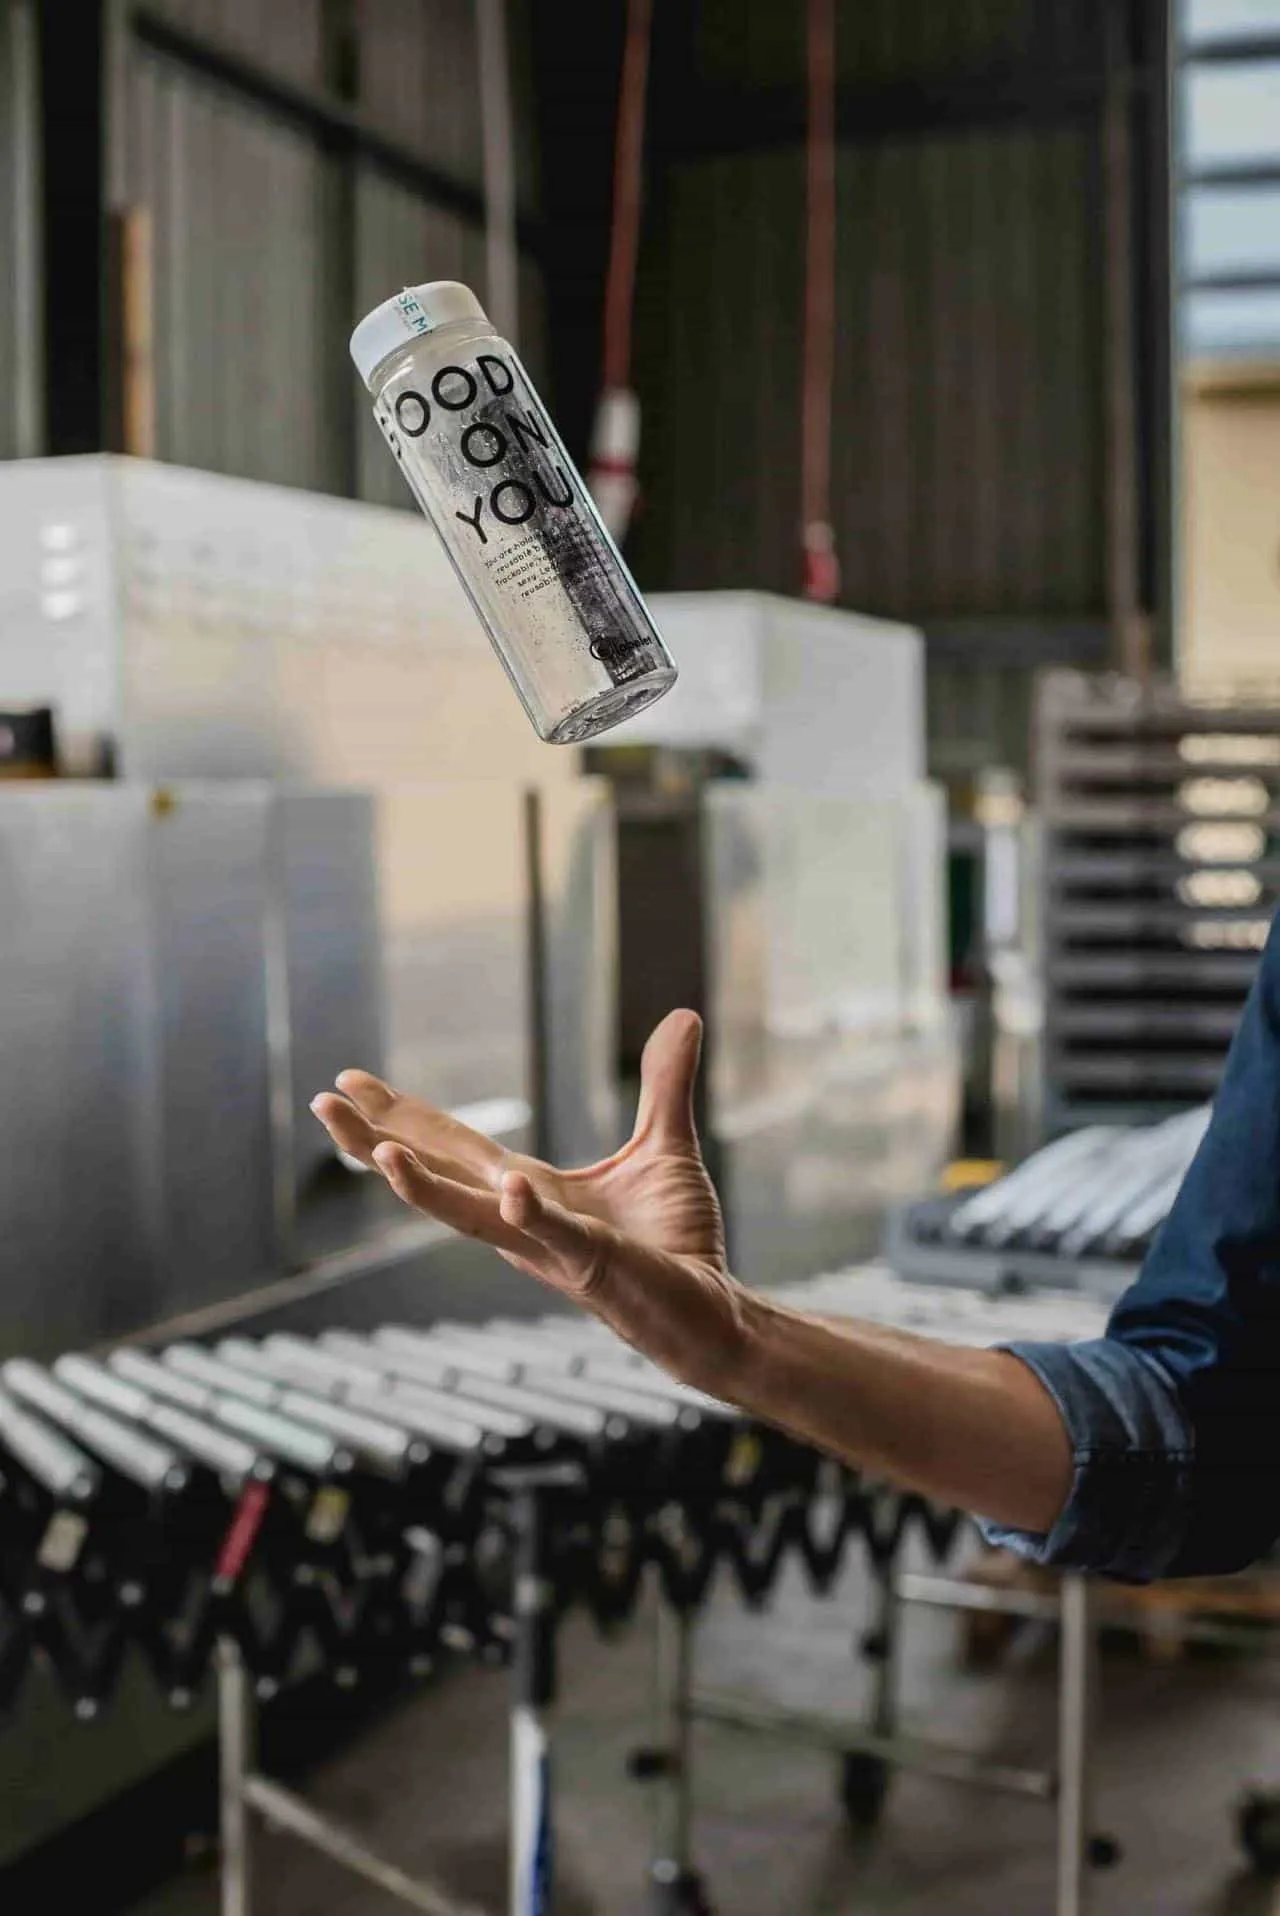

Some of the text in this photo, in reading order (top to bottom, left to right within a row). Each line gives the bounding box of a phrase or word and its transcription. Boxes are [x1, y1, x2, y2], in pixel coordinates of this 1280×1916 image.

[399, 294, 420, 316] SE
[380, 355, 514, 458] OOD
[461, 410, 549, 468] ON
[456, 466, 574, 544] YOU
